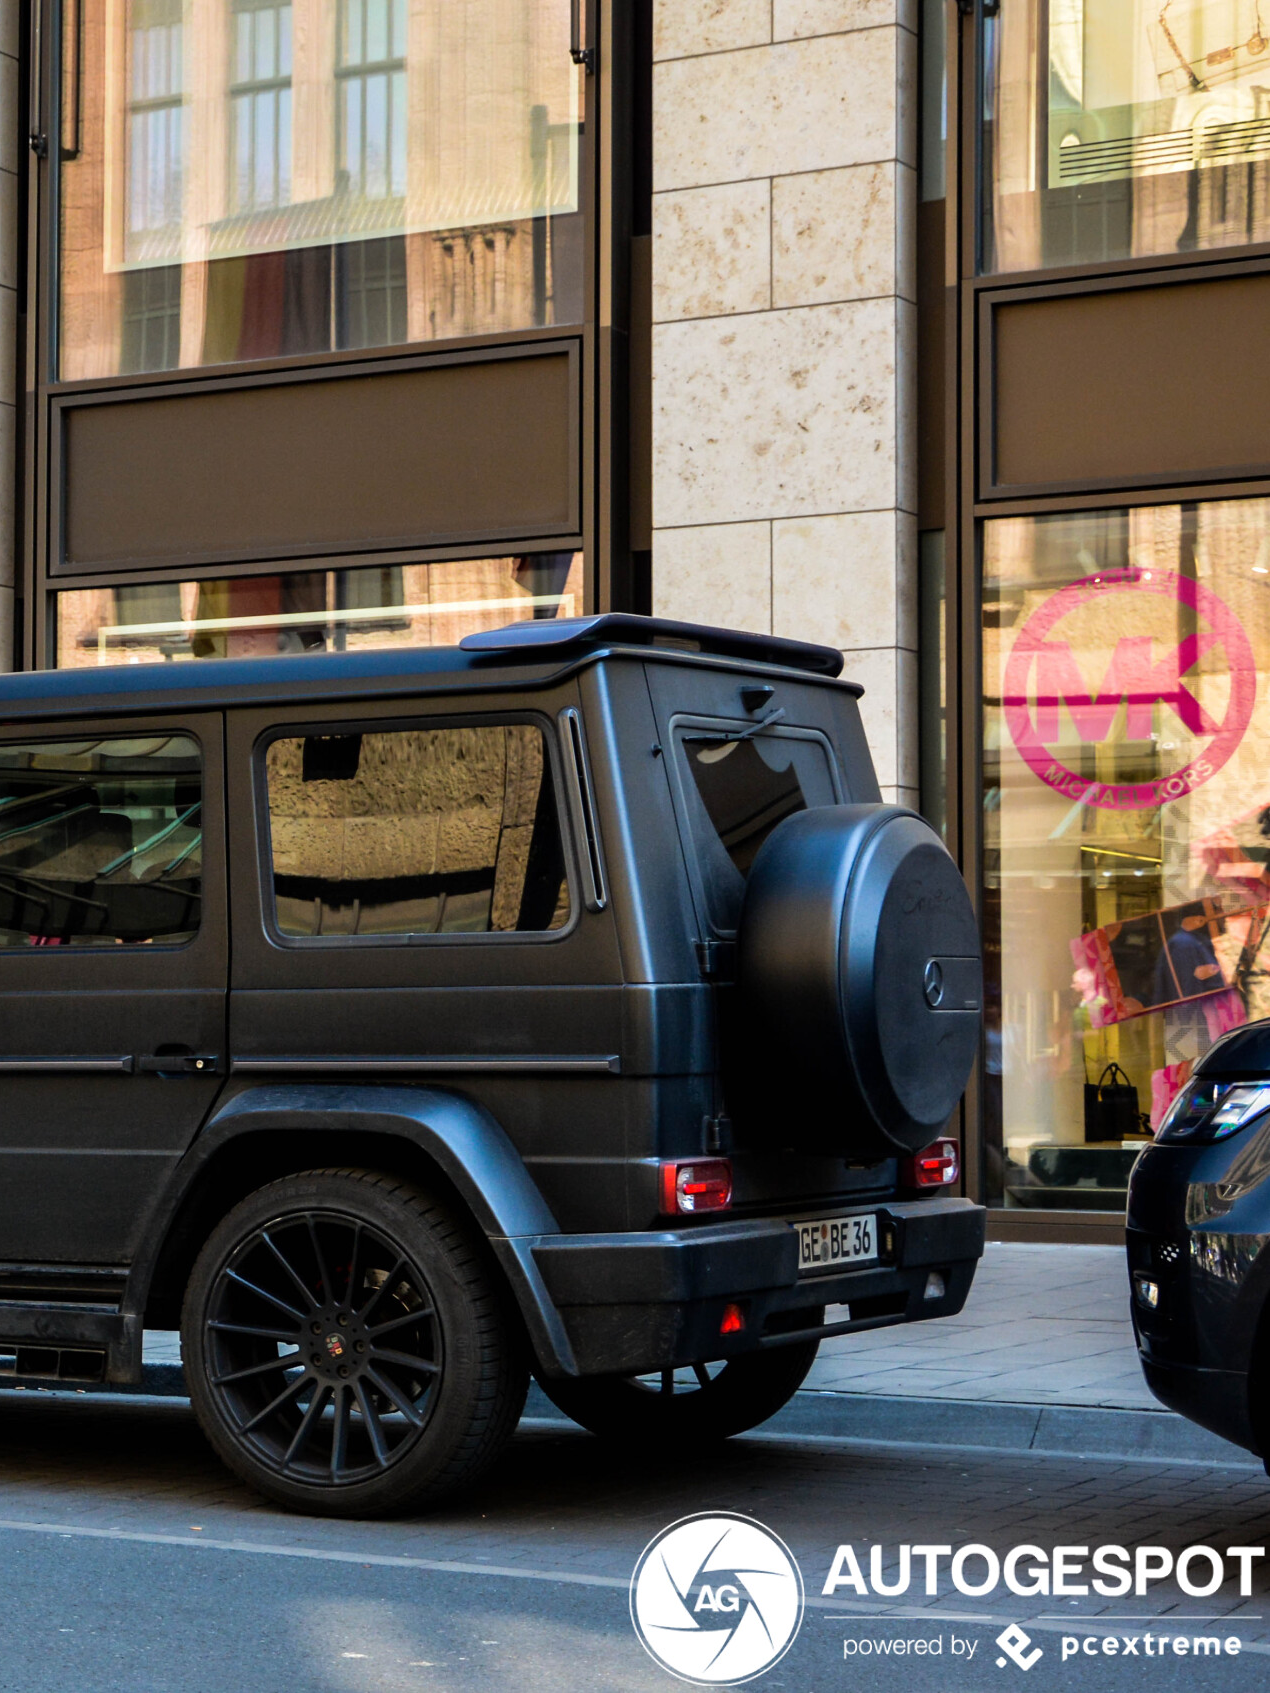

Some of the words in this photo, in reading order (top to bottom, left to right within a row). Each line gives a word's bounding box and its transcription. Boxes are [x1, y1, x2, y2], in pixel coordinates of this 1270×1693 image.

[1152, 759, 1214, 801] KORS
[800, 1226, 821, 1263] GE
[830, 1222, 850, 1259] BE
[853, 1220, 871, 1255] 36
